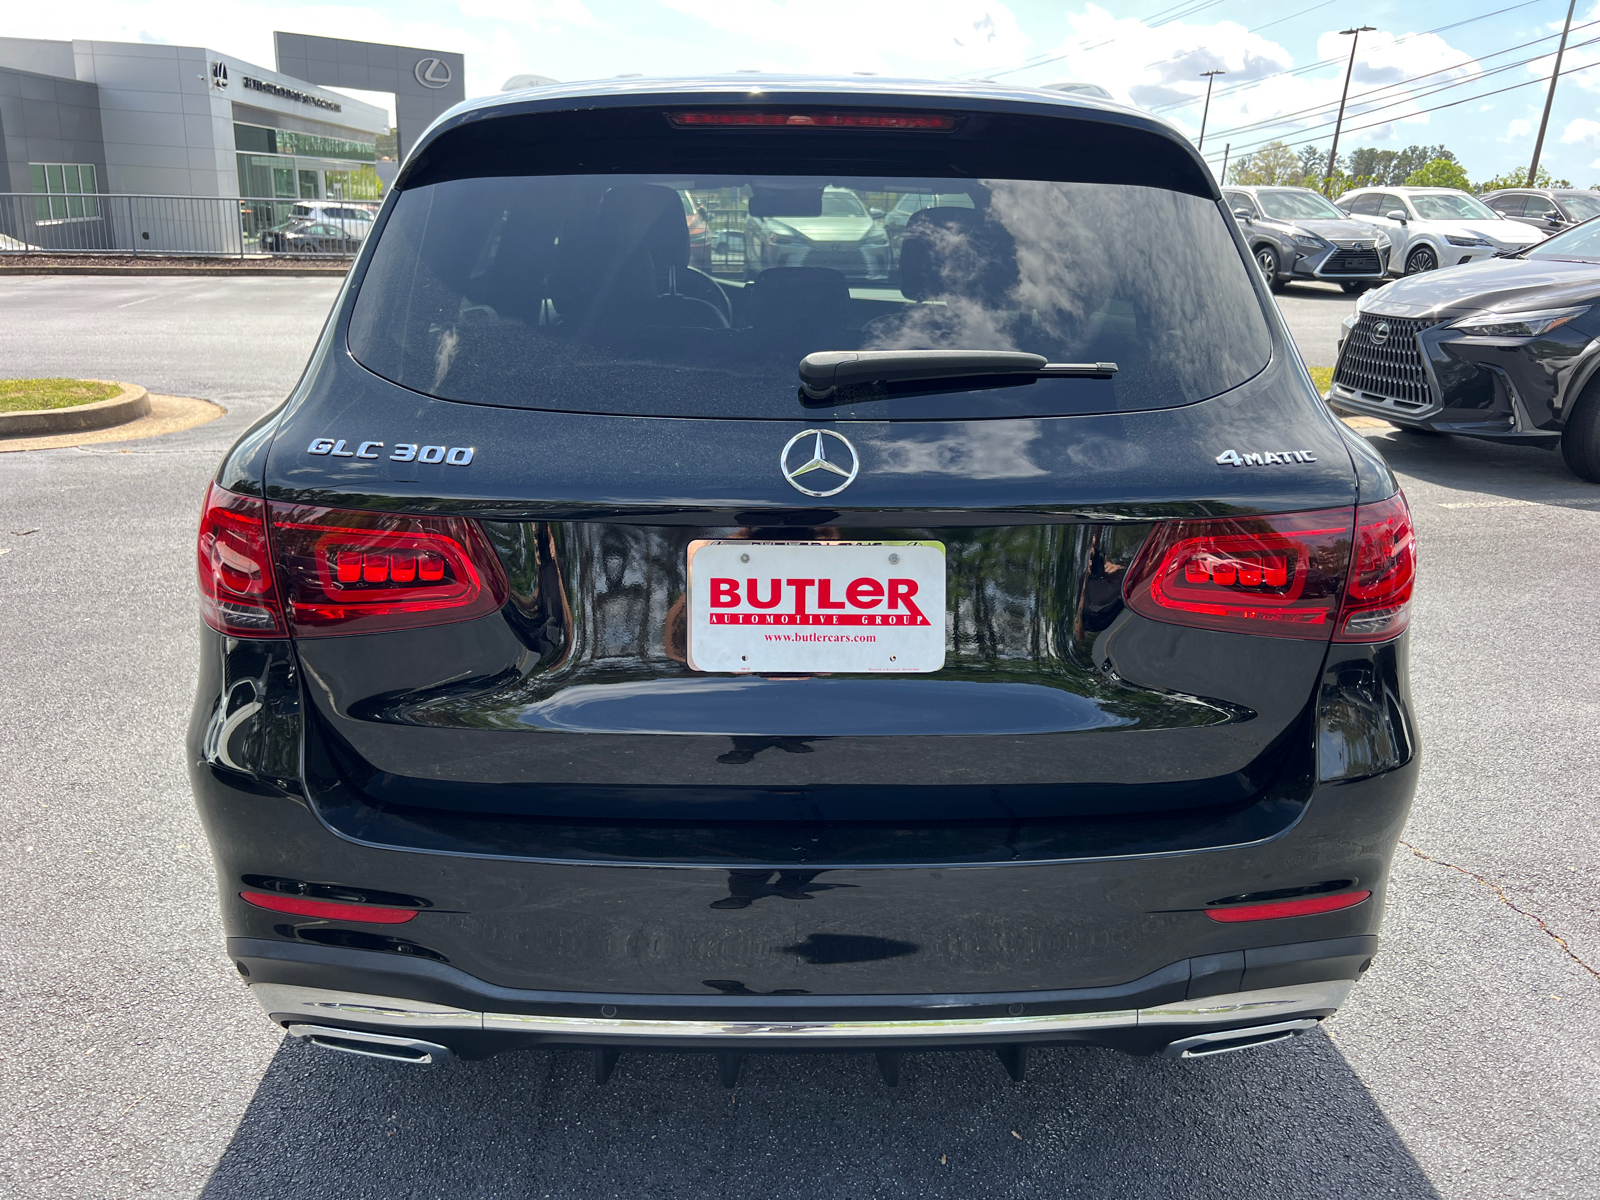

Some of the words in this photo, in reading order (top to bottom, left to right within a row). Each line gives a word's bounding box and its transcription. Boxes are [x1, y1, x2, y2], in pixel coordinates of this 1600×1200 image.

[307, 437, 384, 459] GLC
[389, 443, 474, 466] 300
[1216, 449, 1318, 467] 4MATIC
[710, 614, 840, 625] AUTOMOTIVE
[861, 615, 924, 626] GROUP
[764, 632, 877, 643] www.butlercars.com
